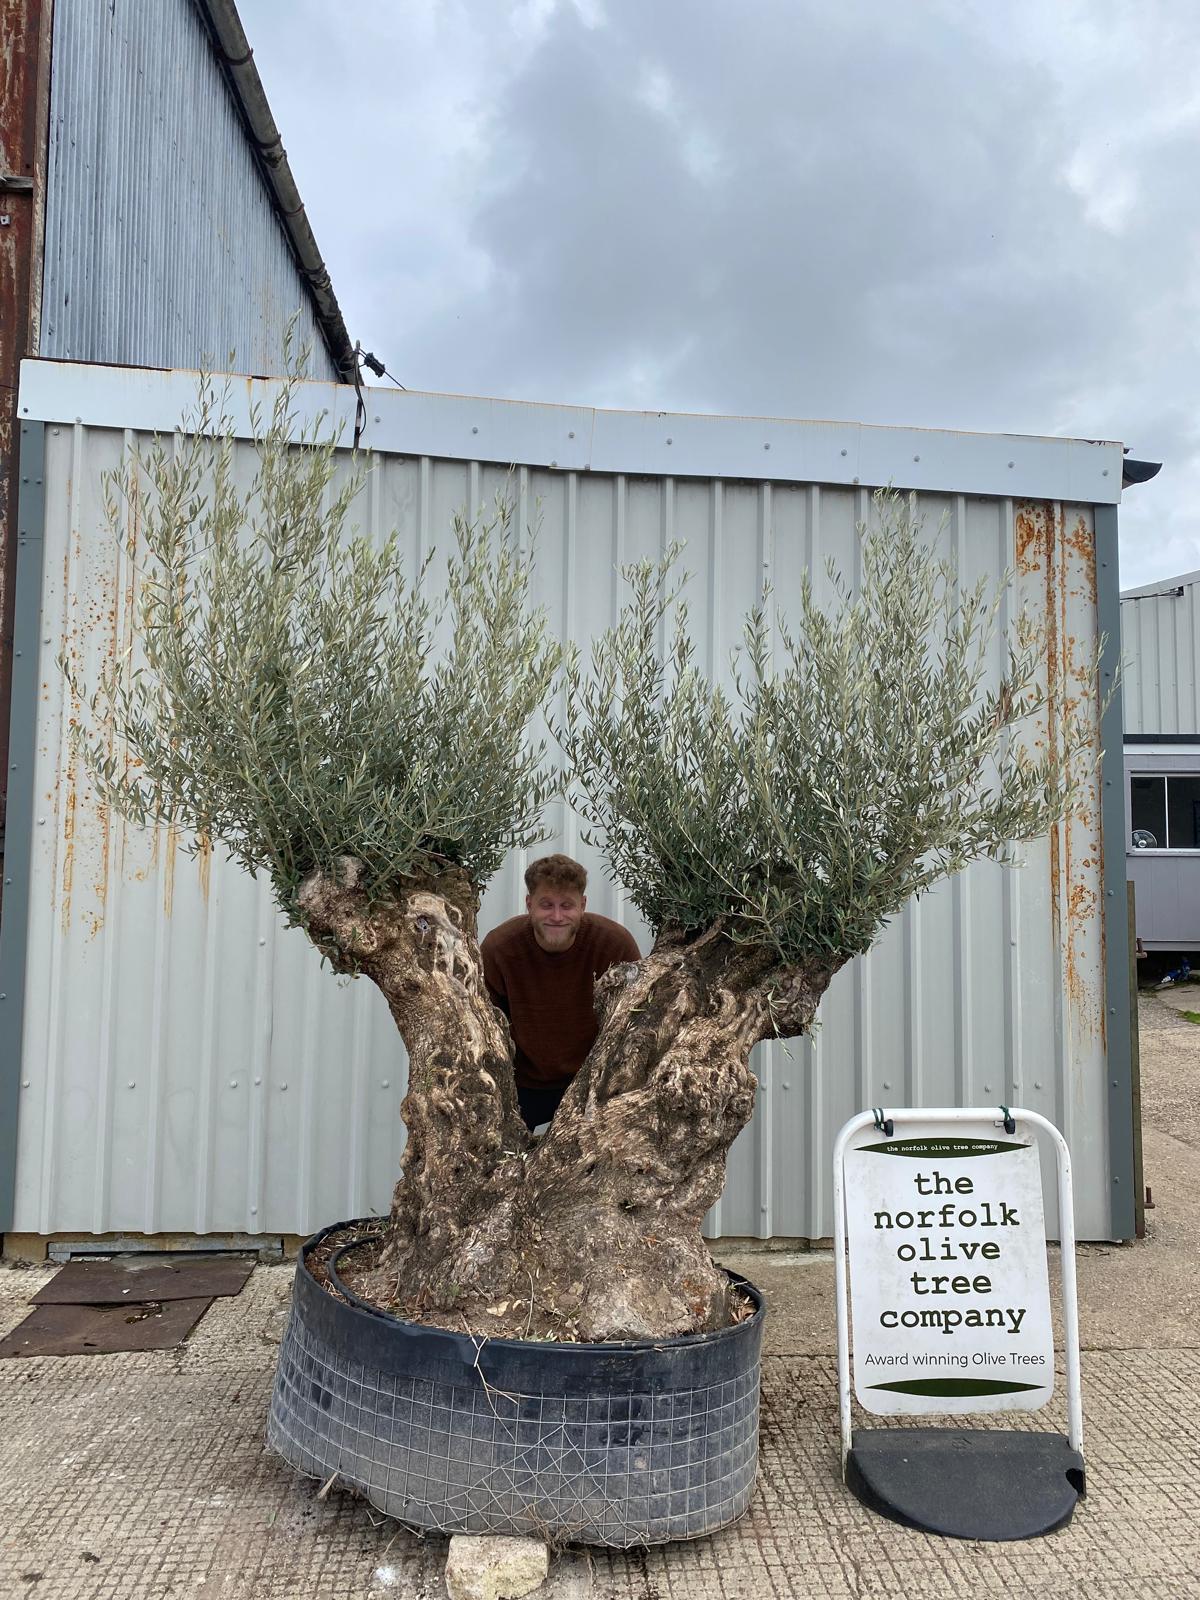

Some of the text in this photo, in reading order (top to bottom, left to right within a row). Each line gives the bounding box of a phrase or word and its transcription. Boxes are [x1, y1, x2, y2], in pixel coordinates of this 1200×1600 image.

[901, 1144, 927, 1152] norfolk
[972, 1143, 998, 1152] company
[914, 1172, 973, 1195] the
[874, 1203, 1020, 1229] norfolk
[897, 1237, 1000, 1261] olive
[910, 1272, 991, 1295] tree
[880, 1309, 1026, 1334] company
[865, 1352, 1046, 1368] Award winning Olive Trees
